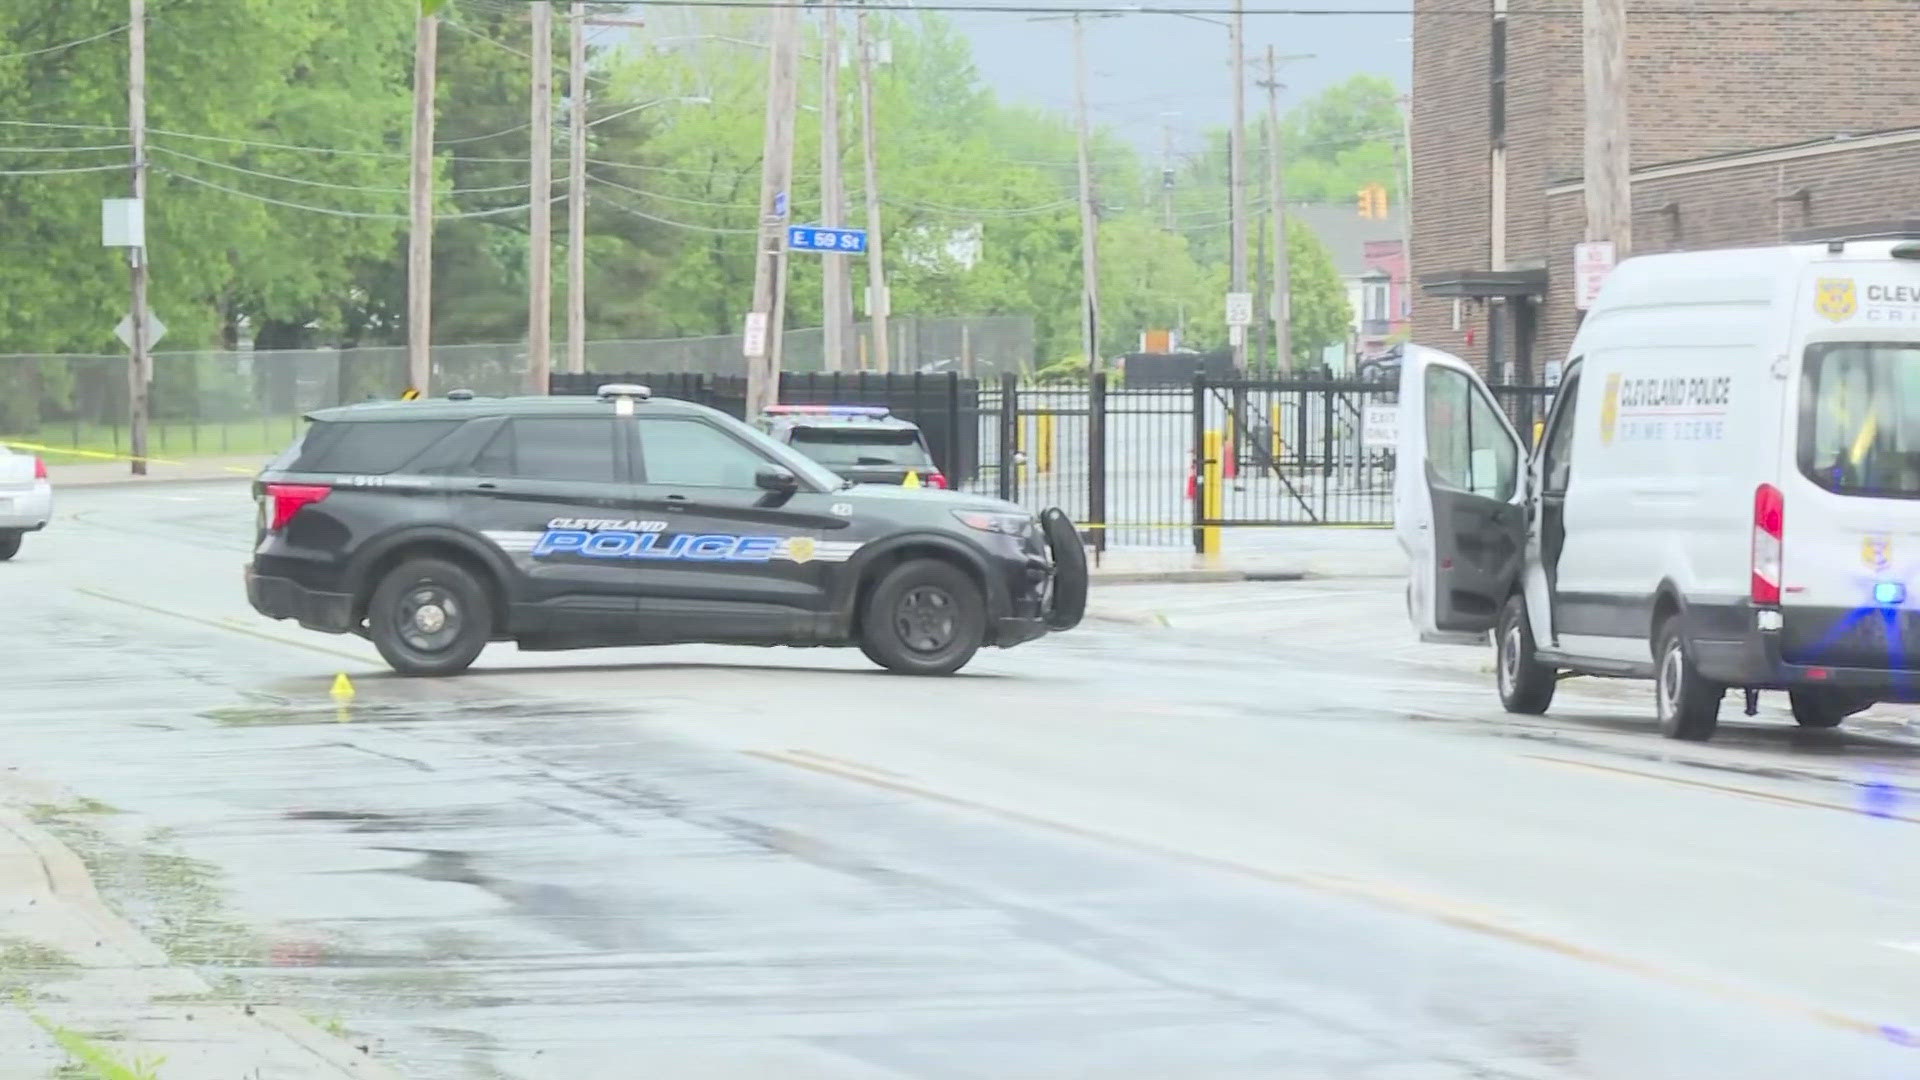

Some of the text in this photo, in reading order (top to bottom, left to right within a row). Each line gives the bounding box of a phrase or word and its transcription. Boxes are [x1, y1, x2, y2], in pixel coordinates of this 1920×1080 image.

[814, 232, 837, 248] 59
[840, 234, 860, 249] St
[1621, 376, 1731, 406] CLEVELAND POLICE
[547, 517, 669, 533] CLEVELAND
[532, 530, 780, 562] POLICE
